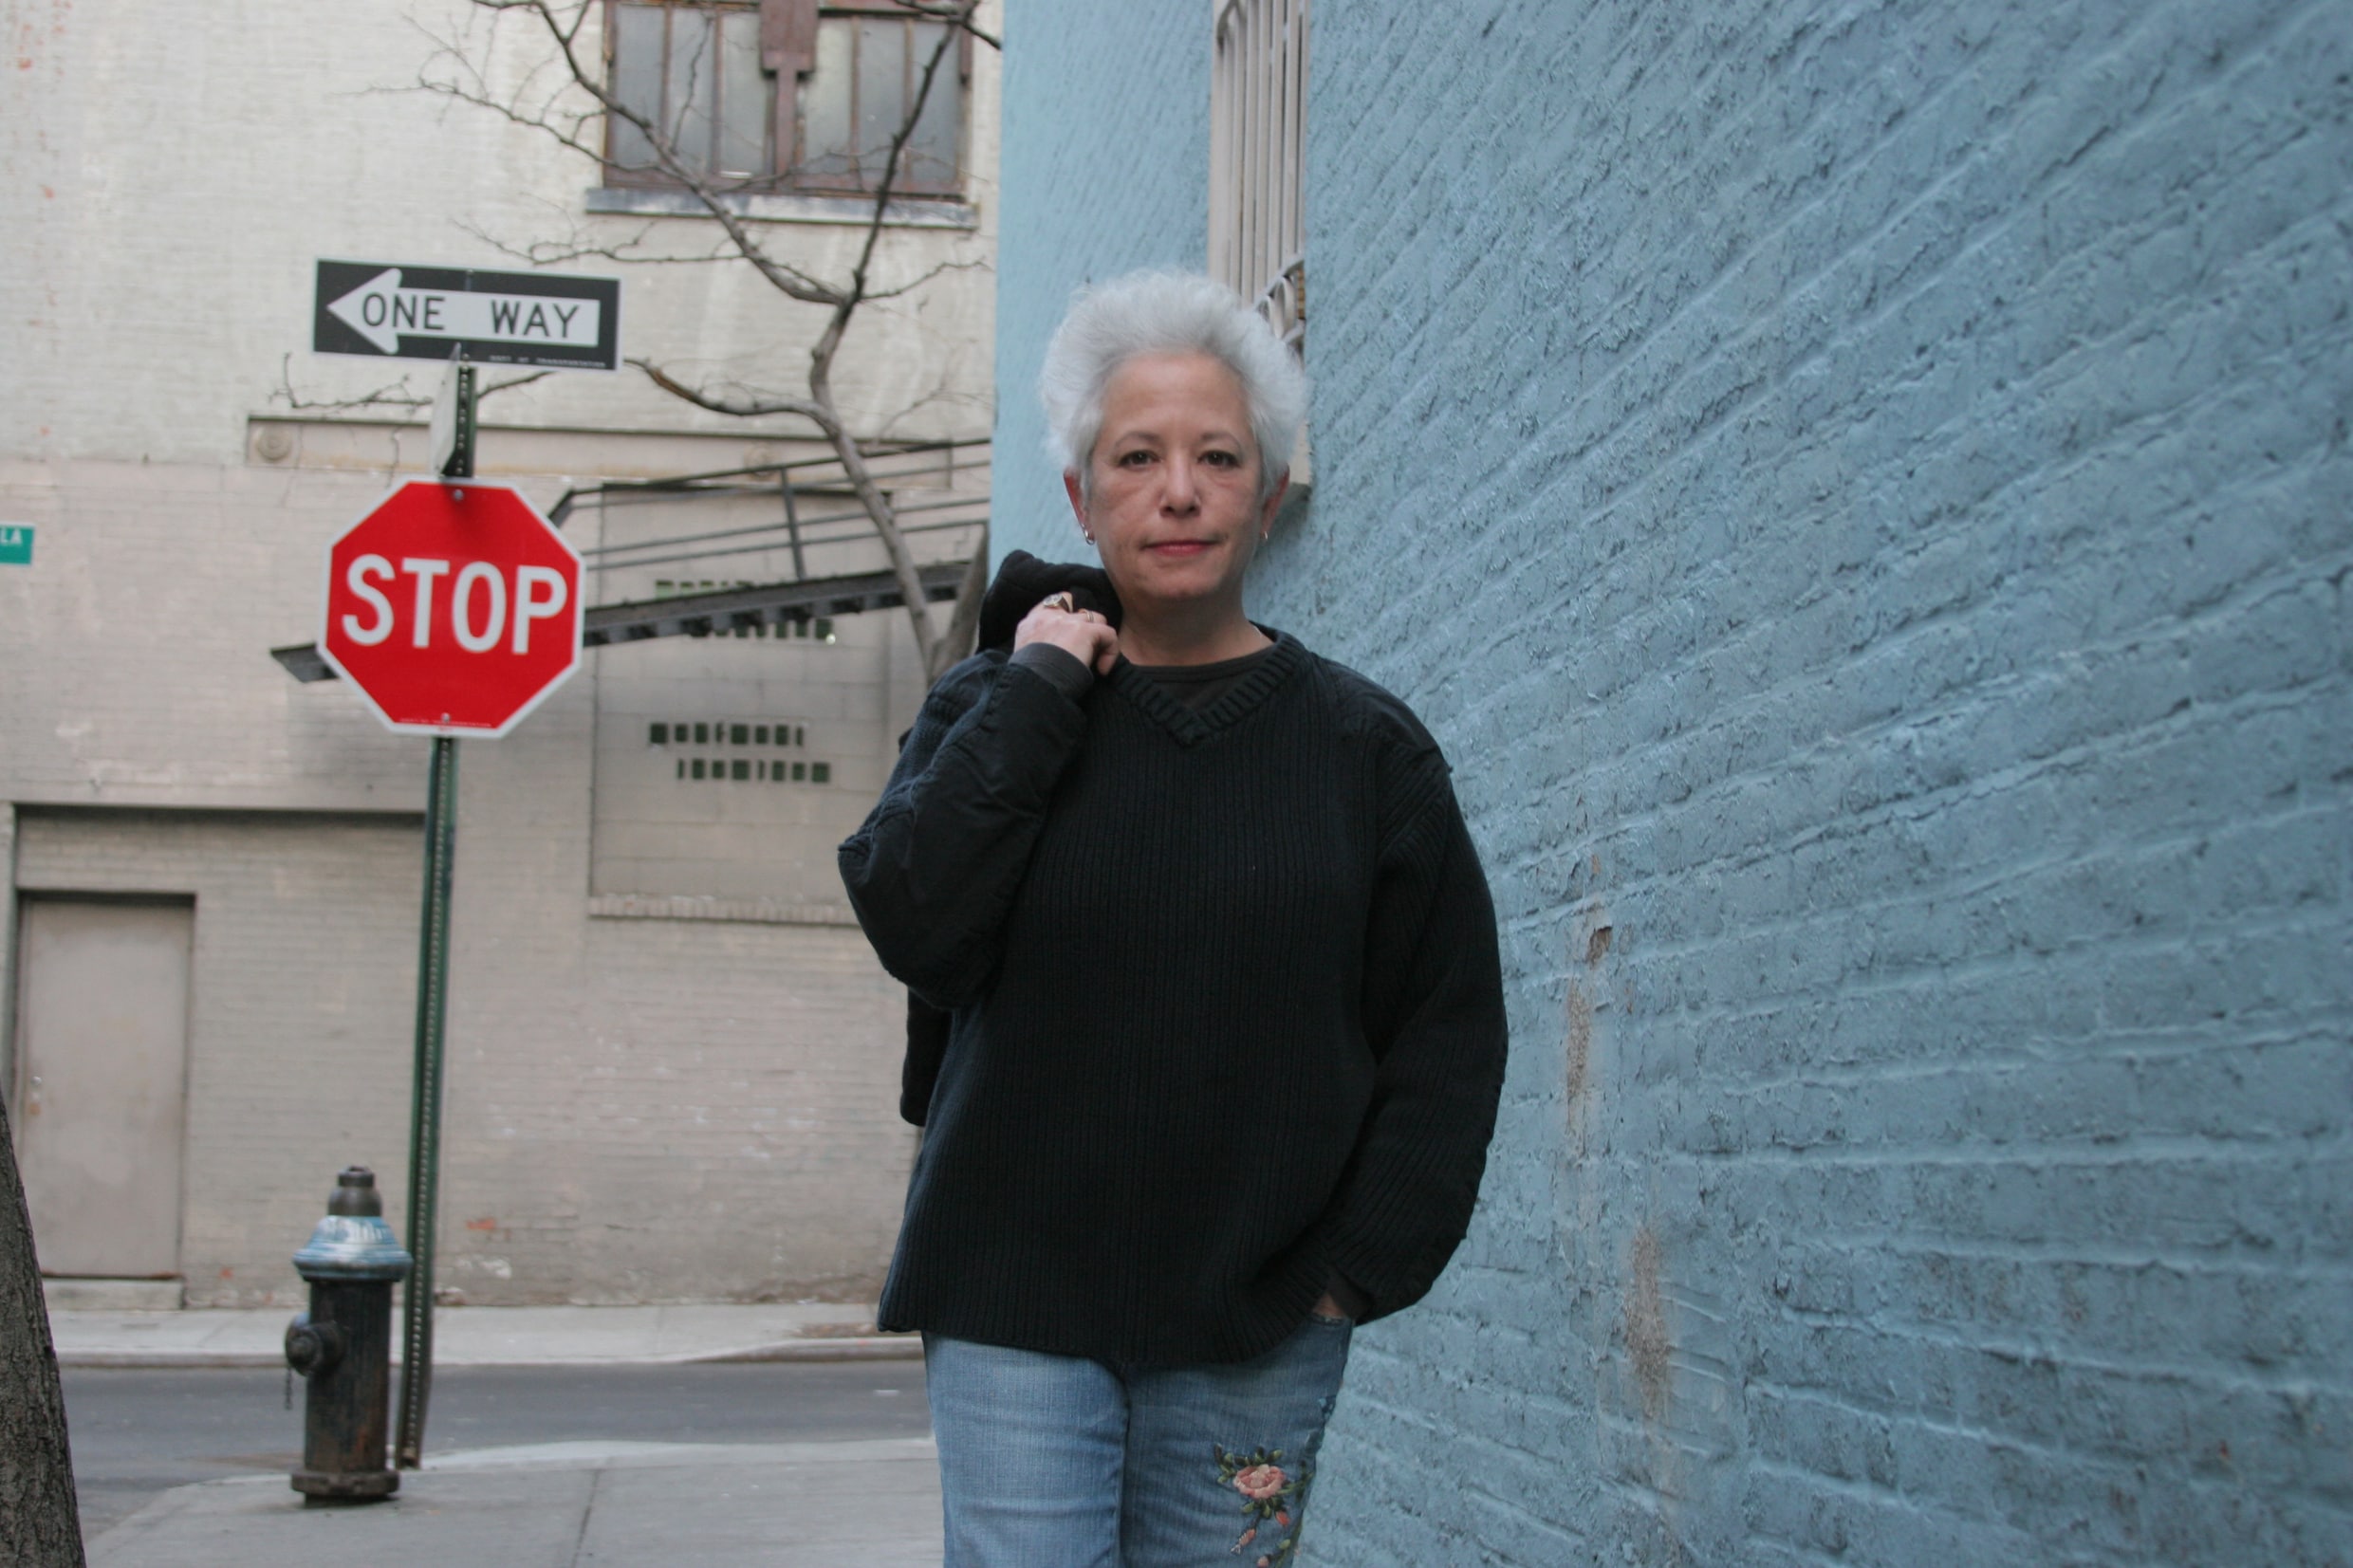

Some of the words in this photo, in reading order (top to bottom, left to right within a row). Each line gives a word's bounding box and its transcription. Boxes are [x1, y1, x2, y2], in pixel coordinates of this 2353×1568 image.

[361, 292, 445, 330] ONE
[491, 299, 579, 338] WAY
[342, 553, 568, 655] STOP
